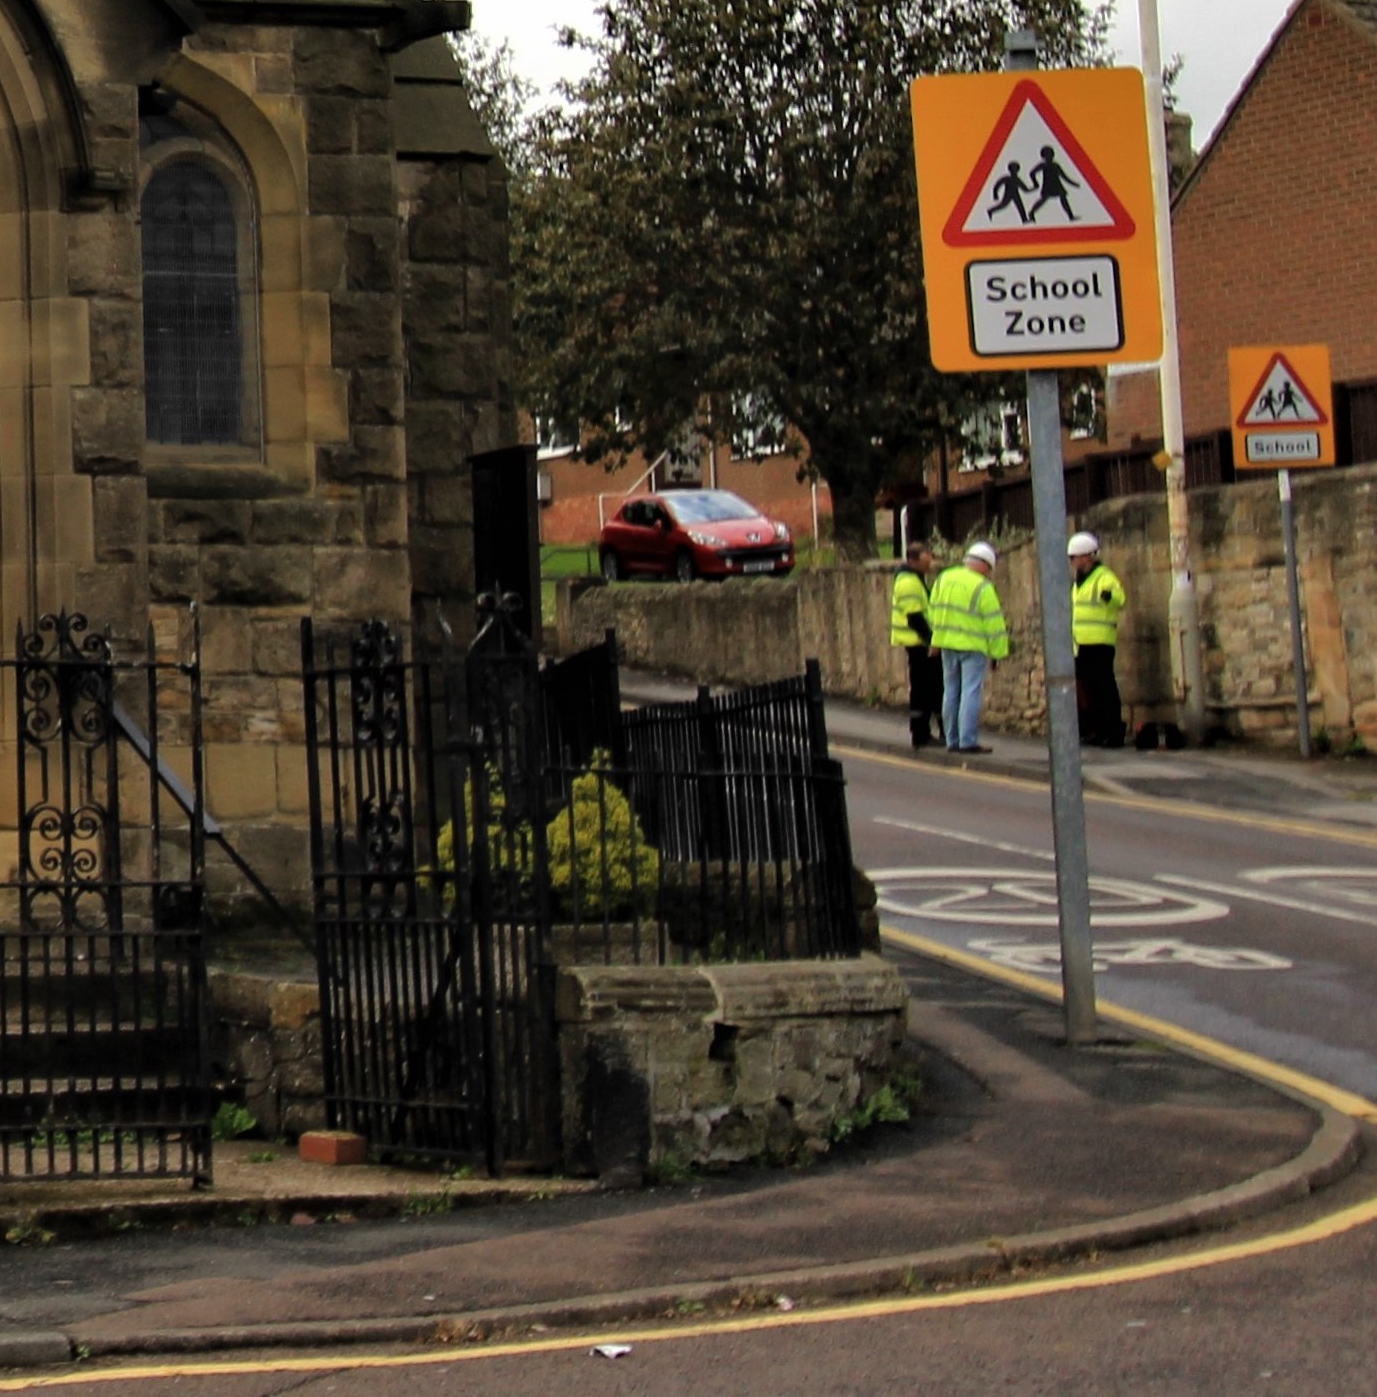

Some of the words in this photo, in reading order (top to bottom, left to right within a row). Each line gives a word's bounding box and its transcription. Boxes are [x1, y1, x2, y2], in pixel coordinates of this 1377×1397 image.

[986, 272, 1102, 302] School
[1004, 310, 1086, 336] Zone
[1254, 439, 1311, 455] School
